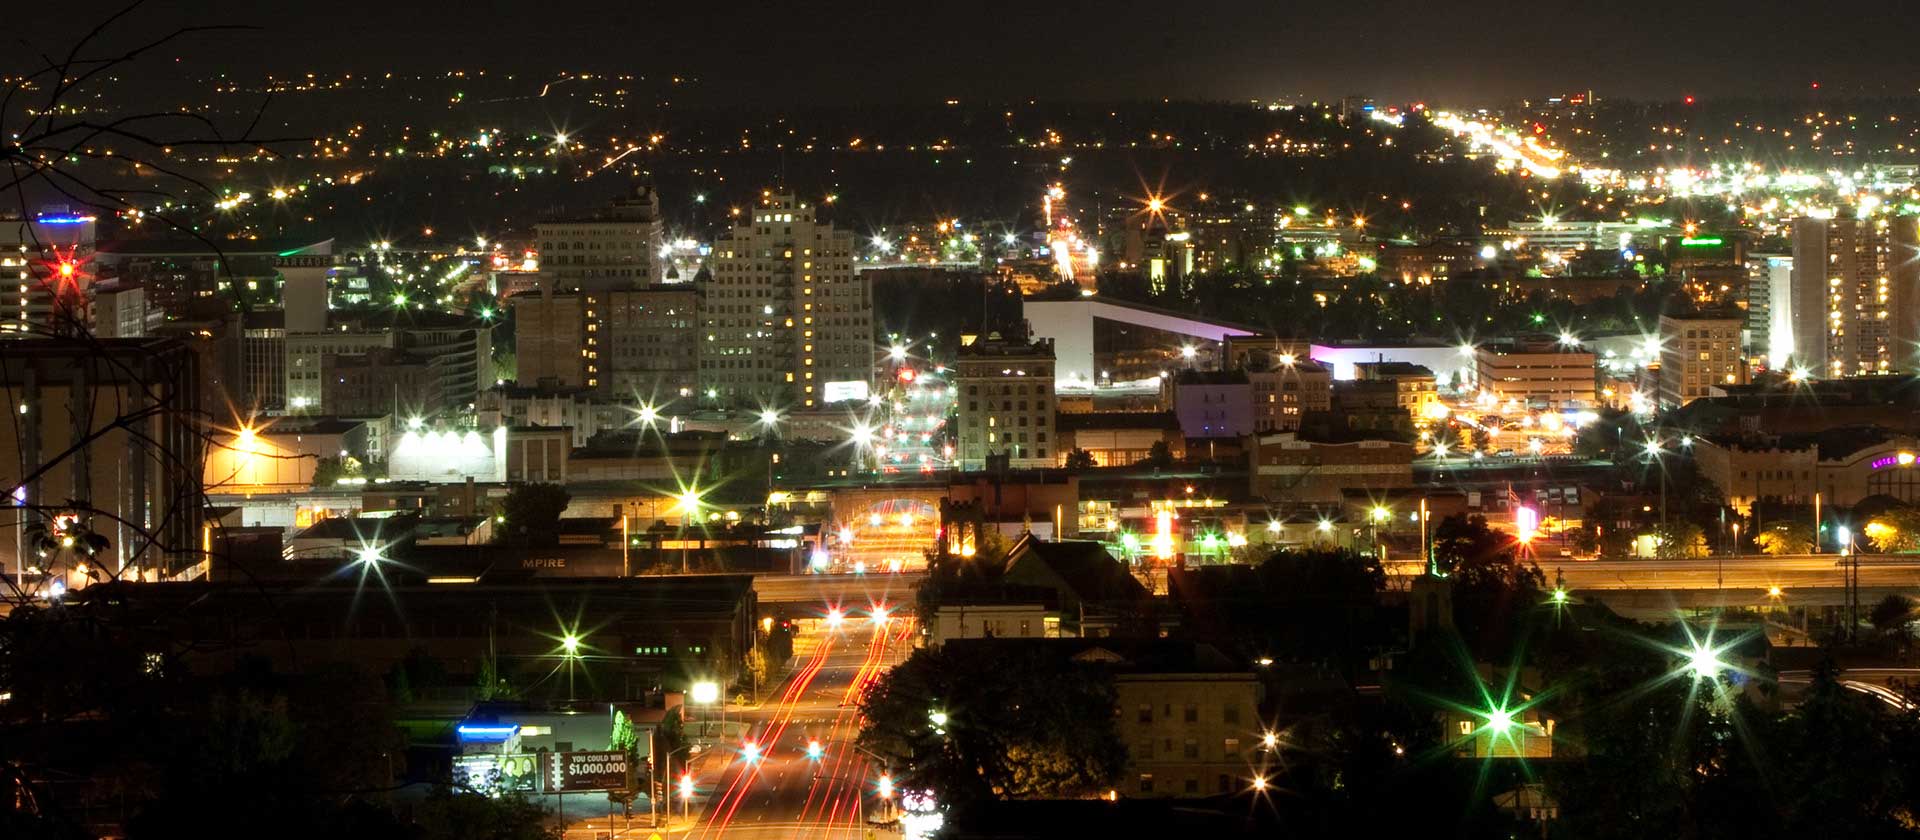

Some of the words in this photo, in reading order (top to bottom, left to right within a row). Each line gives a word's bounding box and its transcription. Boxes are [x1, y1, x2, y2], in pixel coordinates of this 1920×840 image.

[274, 257, 328, 266] PARKADE
[572, 755, 586, 763] YOU
[587, 754, 609, 762] COULD
[569, 762, 626, 776] $1,000,000
